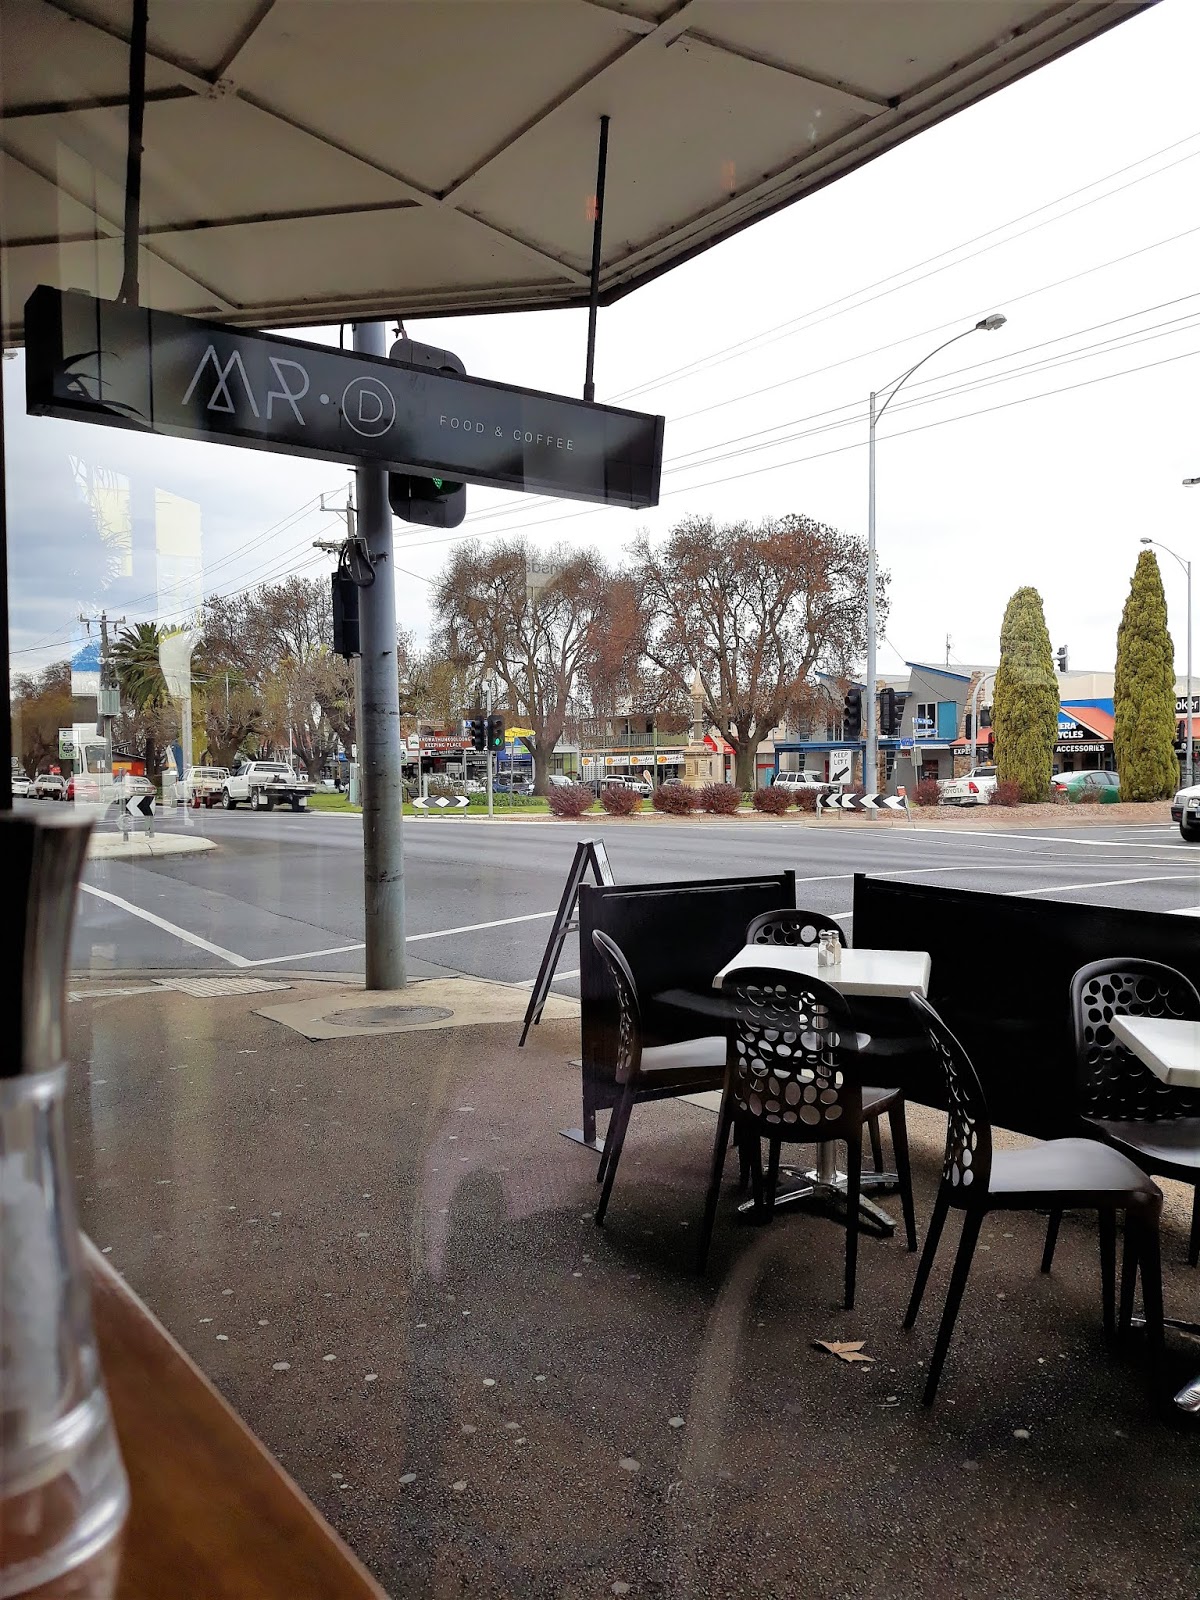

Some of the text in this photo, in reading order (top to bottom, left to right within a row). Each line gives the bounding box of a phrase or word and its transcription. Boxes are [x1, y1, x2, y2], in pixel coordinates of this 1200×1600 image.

[439, 414, 575, 453] FOOD & COFFEE
[1056, 744, 1105, 753] ACCESSORIES
